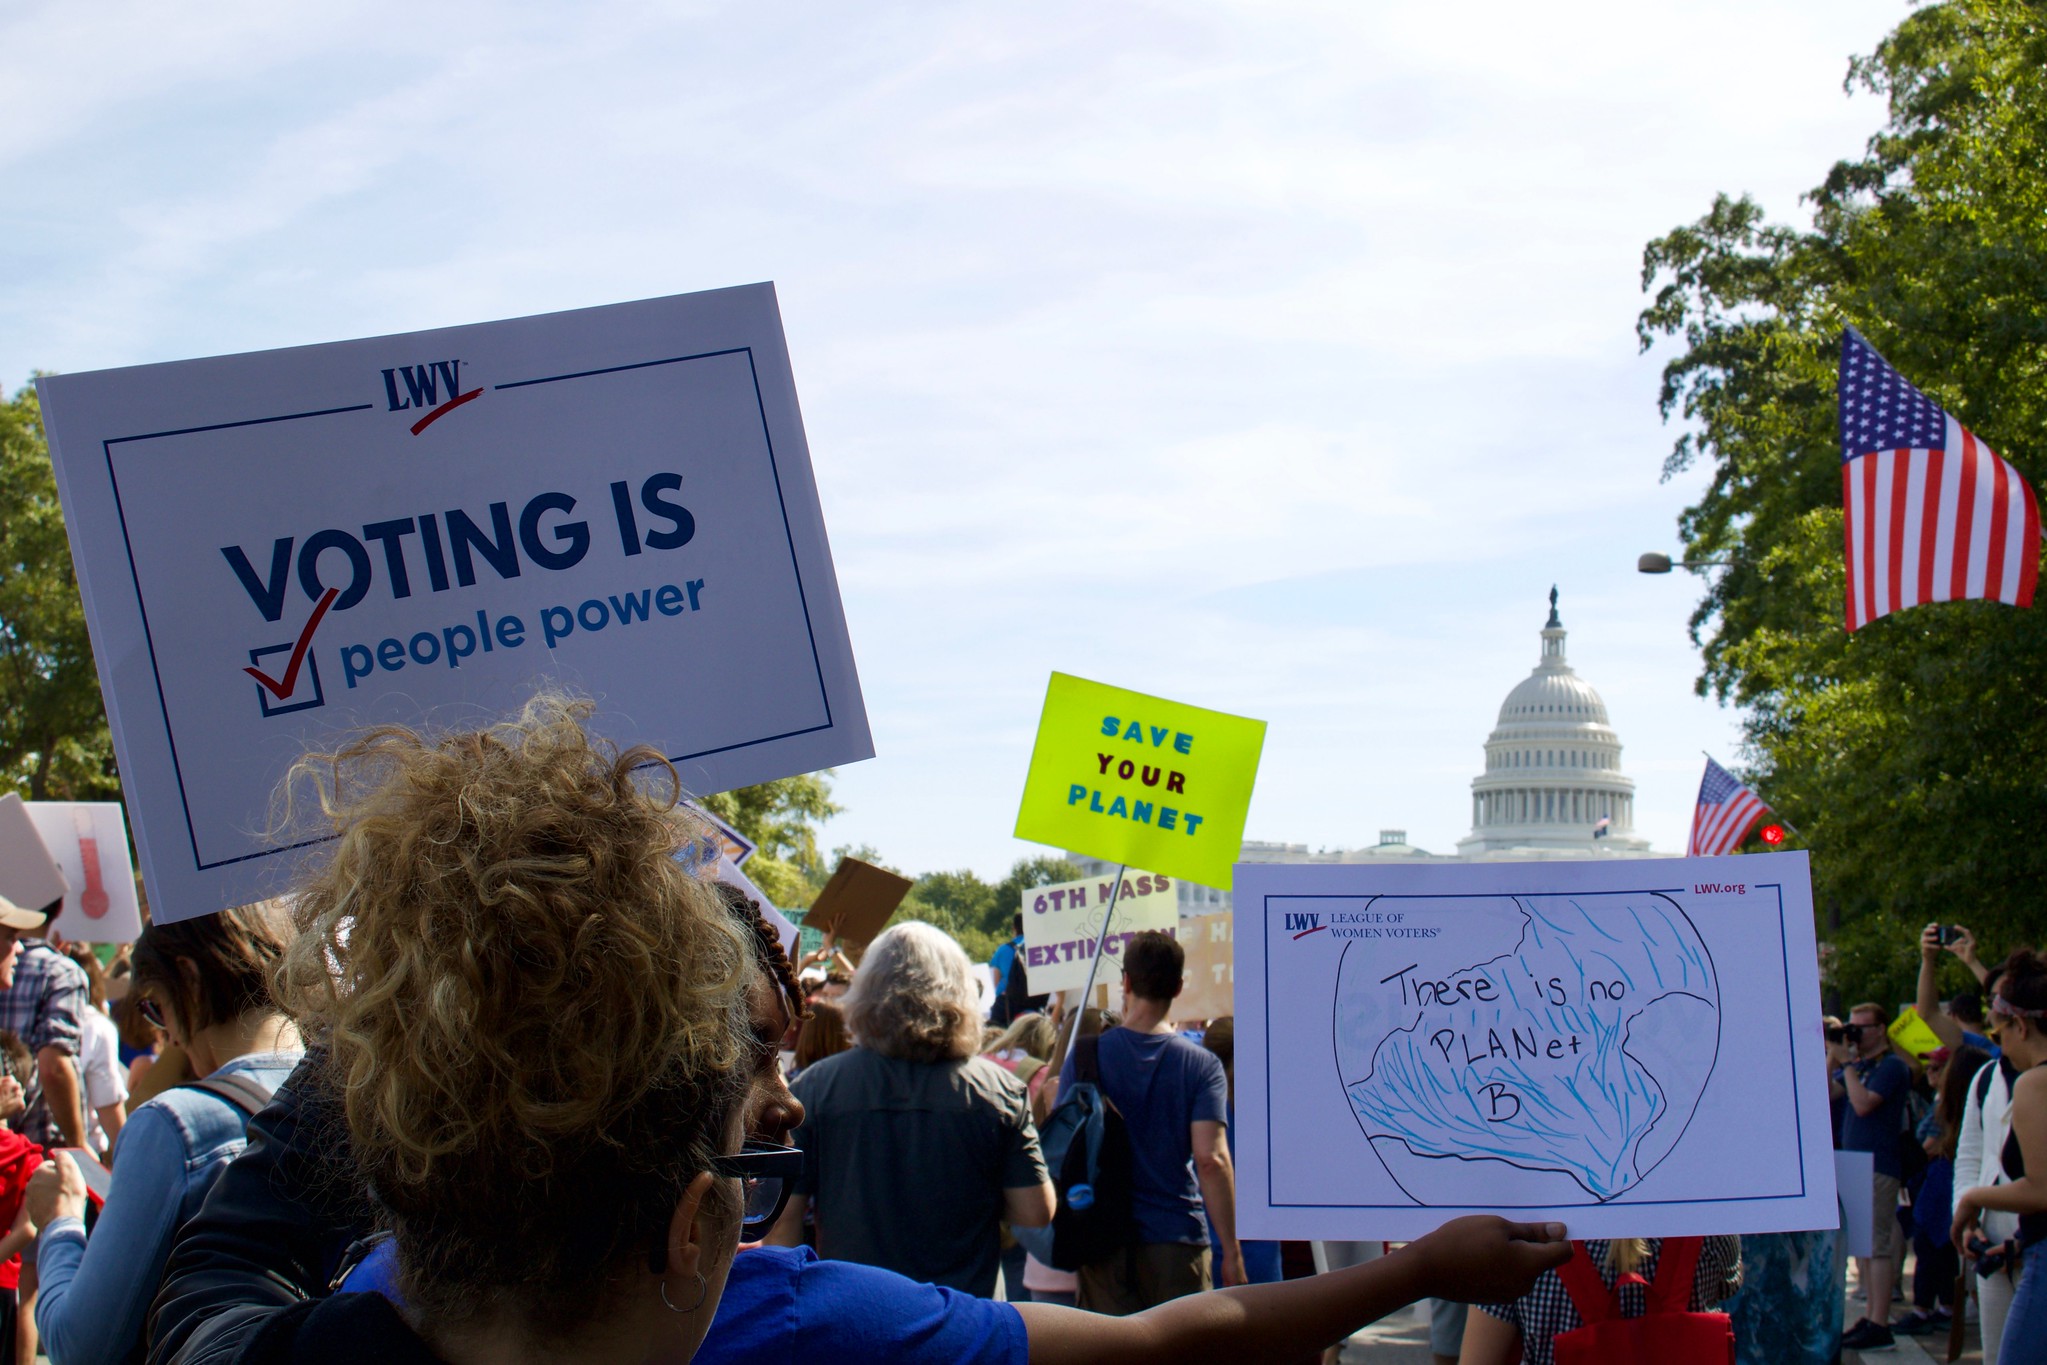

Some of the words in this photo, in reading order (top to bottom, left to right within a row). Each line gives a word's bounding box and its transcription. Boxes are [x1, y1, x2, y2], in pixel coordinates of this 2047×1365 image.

[220, 492, 590, 622] VOTING
[610, 472, 695, 557] IS
[340, 609, 526, 689] people
[541, 578, 705, 648] power
[1101, 716, 1194, 755] SAVE
[1097, 753, 1186, 794] YOUR
[1067, 784, 1203, 836] PLANET
[1033, 887, 1086, 915] 6TH
[1098, 874, 1170, 903] MASS
[1694, 883, 1746, 895] LWV.org
[1285, 913, 1320, 931] LWV
[1331, 913, 1384, 924] LEAGUE
[1386, 913, 1405, 924] OF
[1331, 928, 1382, 939] WOMEN
[1027, 927, 1176, 967] EXTINCTN
[1380, 963, 1500, 1007] There
[1529, 973, 1567, 1007] is
[1589, 979, 1625, 1001] no
[1477, 1082, 1521, 1122] B
